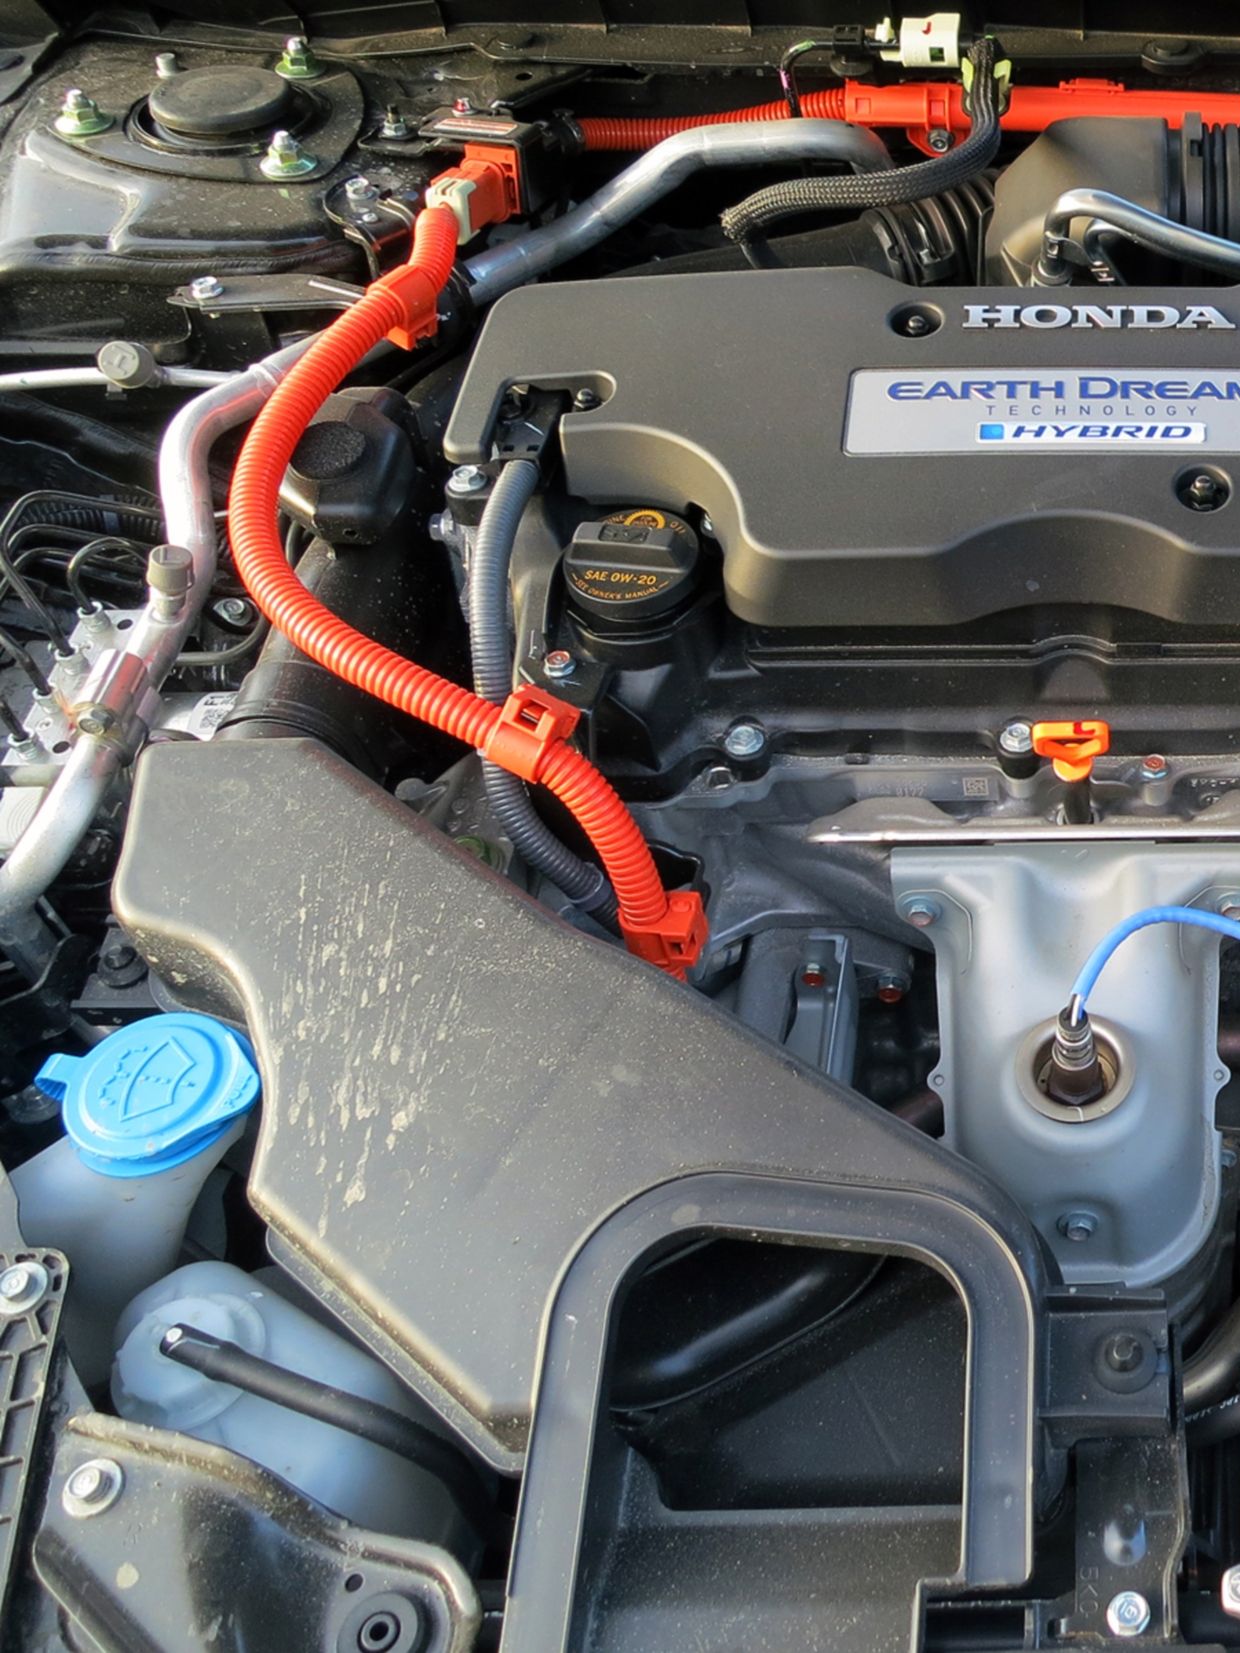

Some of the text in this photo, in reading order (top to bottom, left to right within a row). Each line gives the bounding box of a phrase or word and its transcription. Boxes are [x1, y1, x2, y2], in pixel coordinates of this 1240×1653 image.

[962, 305, 1236, 330] HONDA
[888, 380, 1066, 400] EARTH
[985, 404, 1199, 417] TECHNOLOGY
[1012, 424, 1192, 440] HYBRID
[584, 570, 609, 581] SAE
[624, 587, 659, 599] MANUAL
